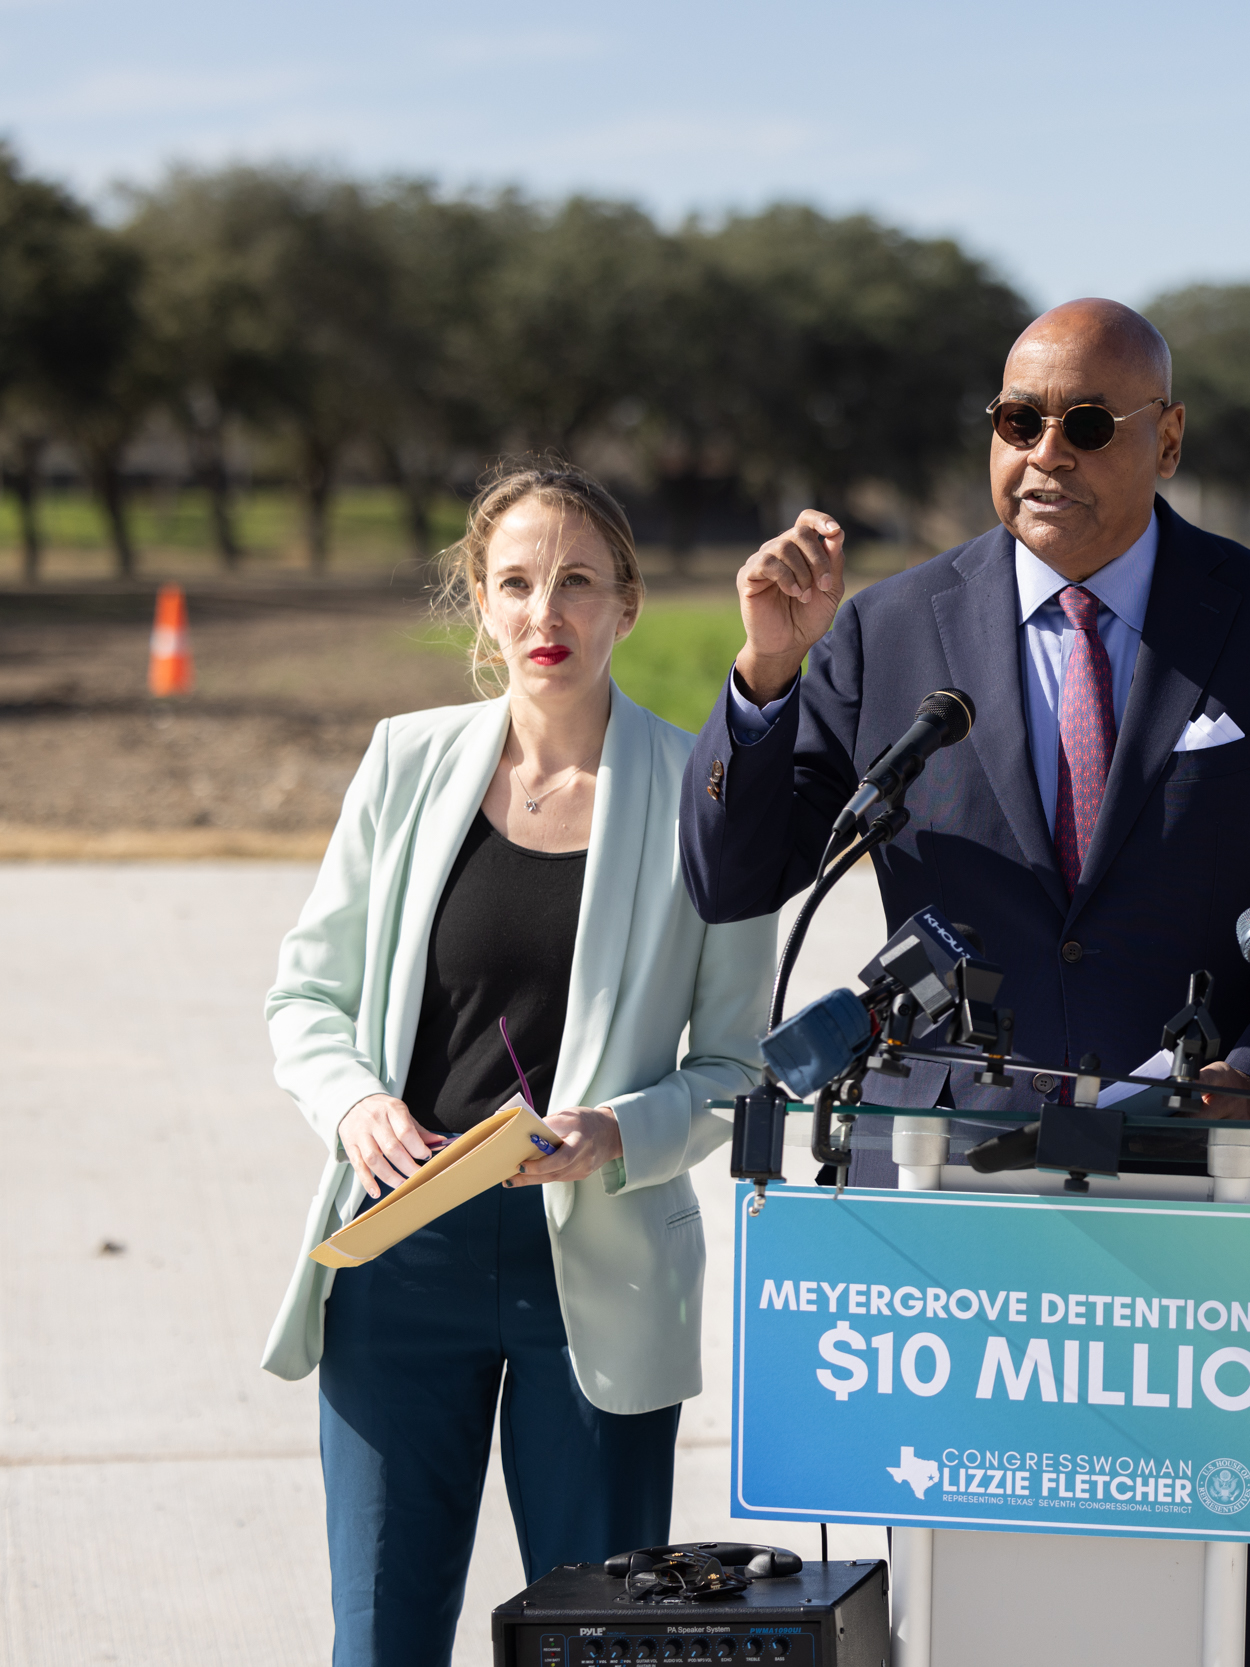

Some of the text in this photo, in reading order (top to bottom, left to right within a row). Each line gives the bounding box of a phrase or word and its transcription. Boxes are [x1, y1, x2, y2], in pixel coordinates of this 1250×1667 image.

[760, 1279, 1027, 1321] MEYERGROVE
[816, 1321, 950, 1401] $10
[942, 1448, 1192, 1477] CONGRESSWOMAN
[1202, 1459, 1250, 1480] U.S. HOUSE OF
[943, 1467, 1192, 1503] LIZZIE FLETCHER
[943, 1494, 1004, 1504] REPRESENTING
[1038, 1499, 1076, 1508] SEVENTH
[1079, 1501, 1152, 1512] CONGRESSIONAL
[1155, 1504, 1192, 1514] DISTRICT
[678, 1626, 705, 1634] Speaker
[706, 1626, 730, 1634] System
